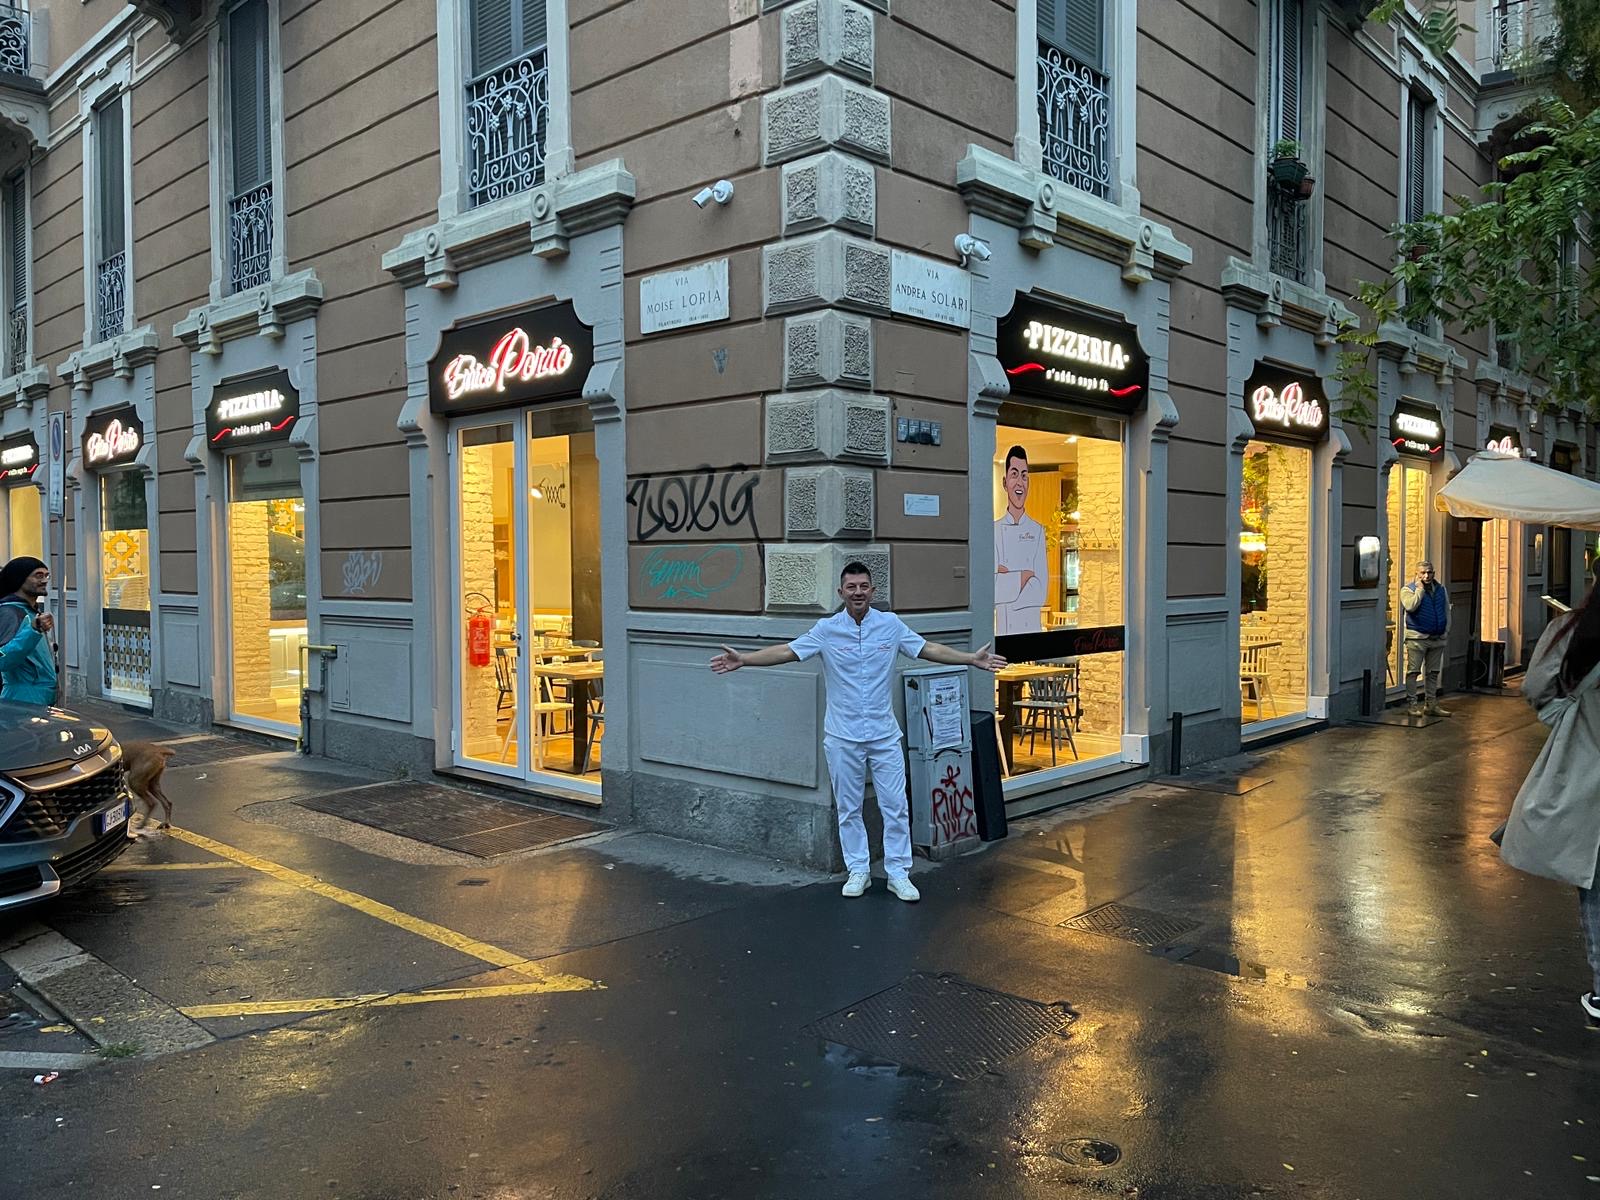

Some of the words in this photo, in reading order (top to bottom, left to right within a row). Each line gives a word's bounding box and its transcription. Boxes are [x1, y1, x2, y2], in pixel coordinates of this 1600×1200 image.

[675, 276, 689, 287] VIA
[926, 268, 939, 280] VIA
[646, 300, 673, 314] MOISE
[682, 289, 721, 308] LORIA
[895, 283, 926, 300] ANDREA
[931, 290, 968, 311] SOLARI
[1028, 320, 1126, 370] PIZZERIA
[219, 389, 282, 420] PIZZERIA
